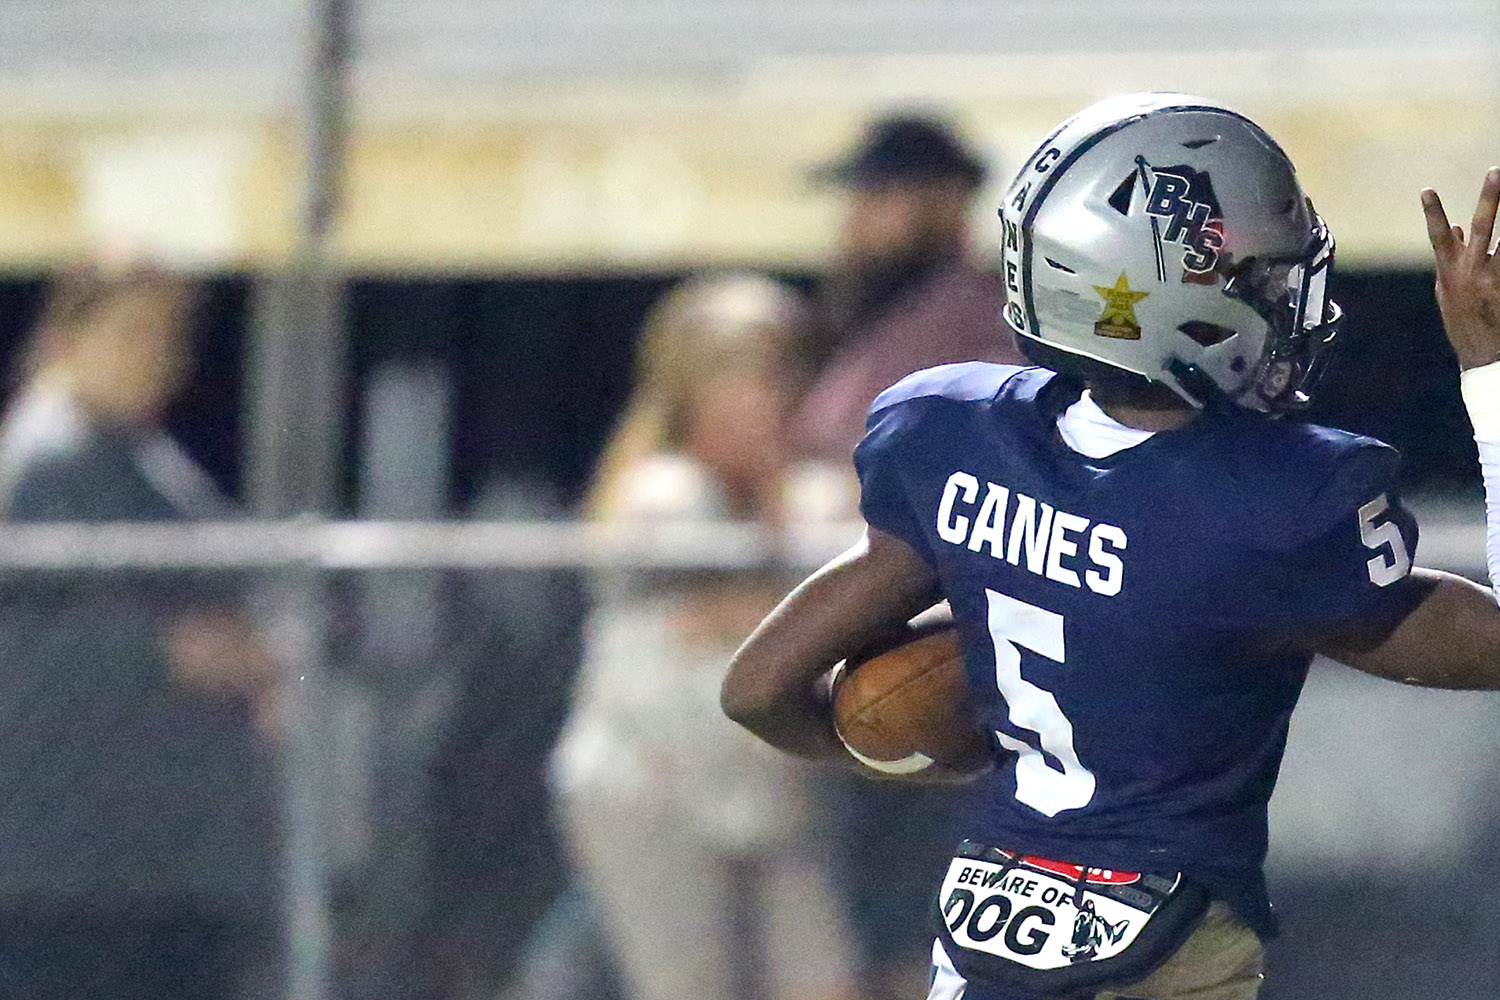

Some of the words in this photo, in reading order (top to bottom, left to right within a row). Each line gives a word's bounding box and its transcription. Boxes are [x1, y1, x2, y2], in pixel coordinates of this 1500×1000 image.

[1144, 171, 1225, 274] BHS
[936, 471, 1127, 596] CANES
[1358, 492, 1409, 587] 5
[985, 588, 1096, 818] 5
[957, 867, 1038, 897] BEWARE
[1041, 887, 1074, 907] OF
